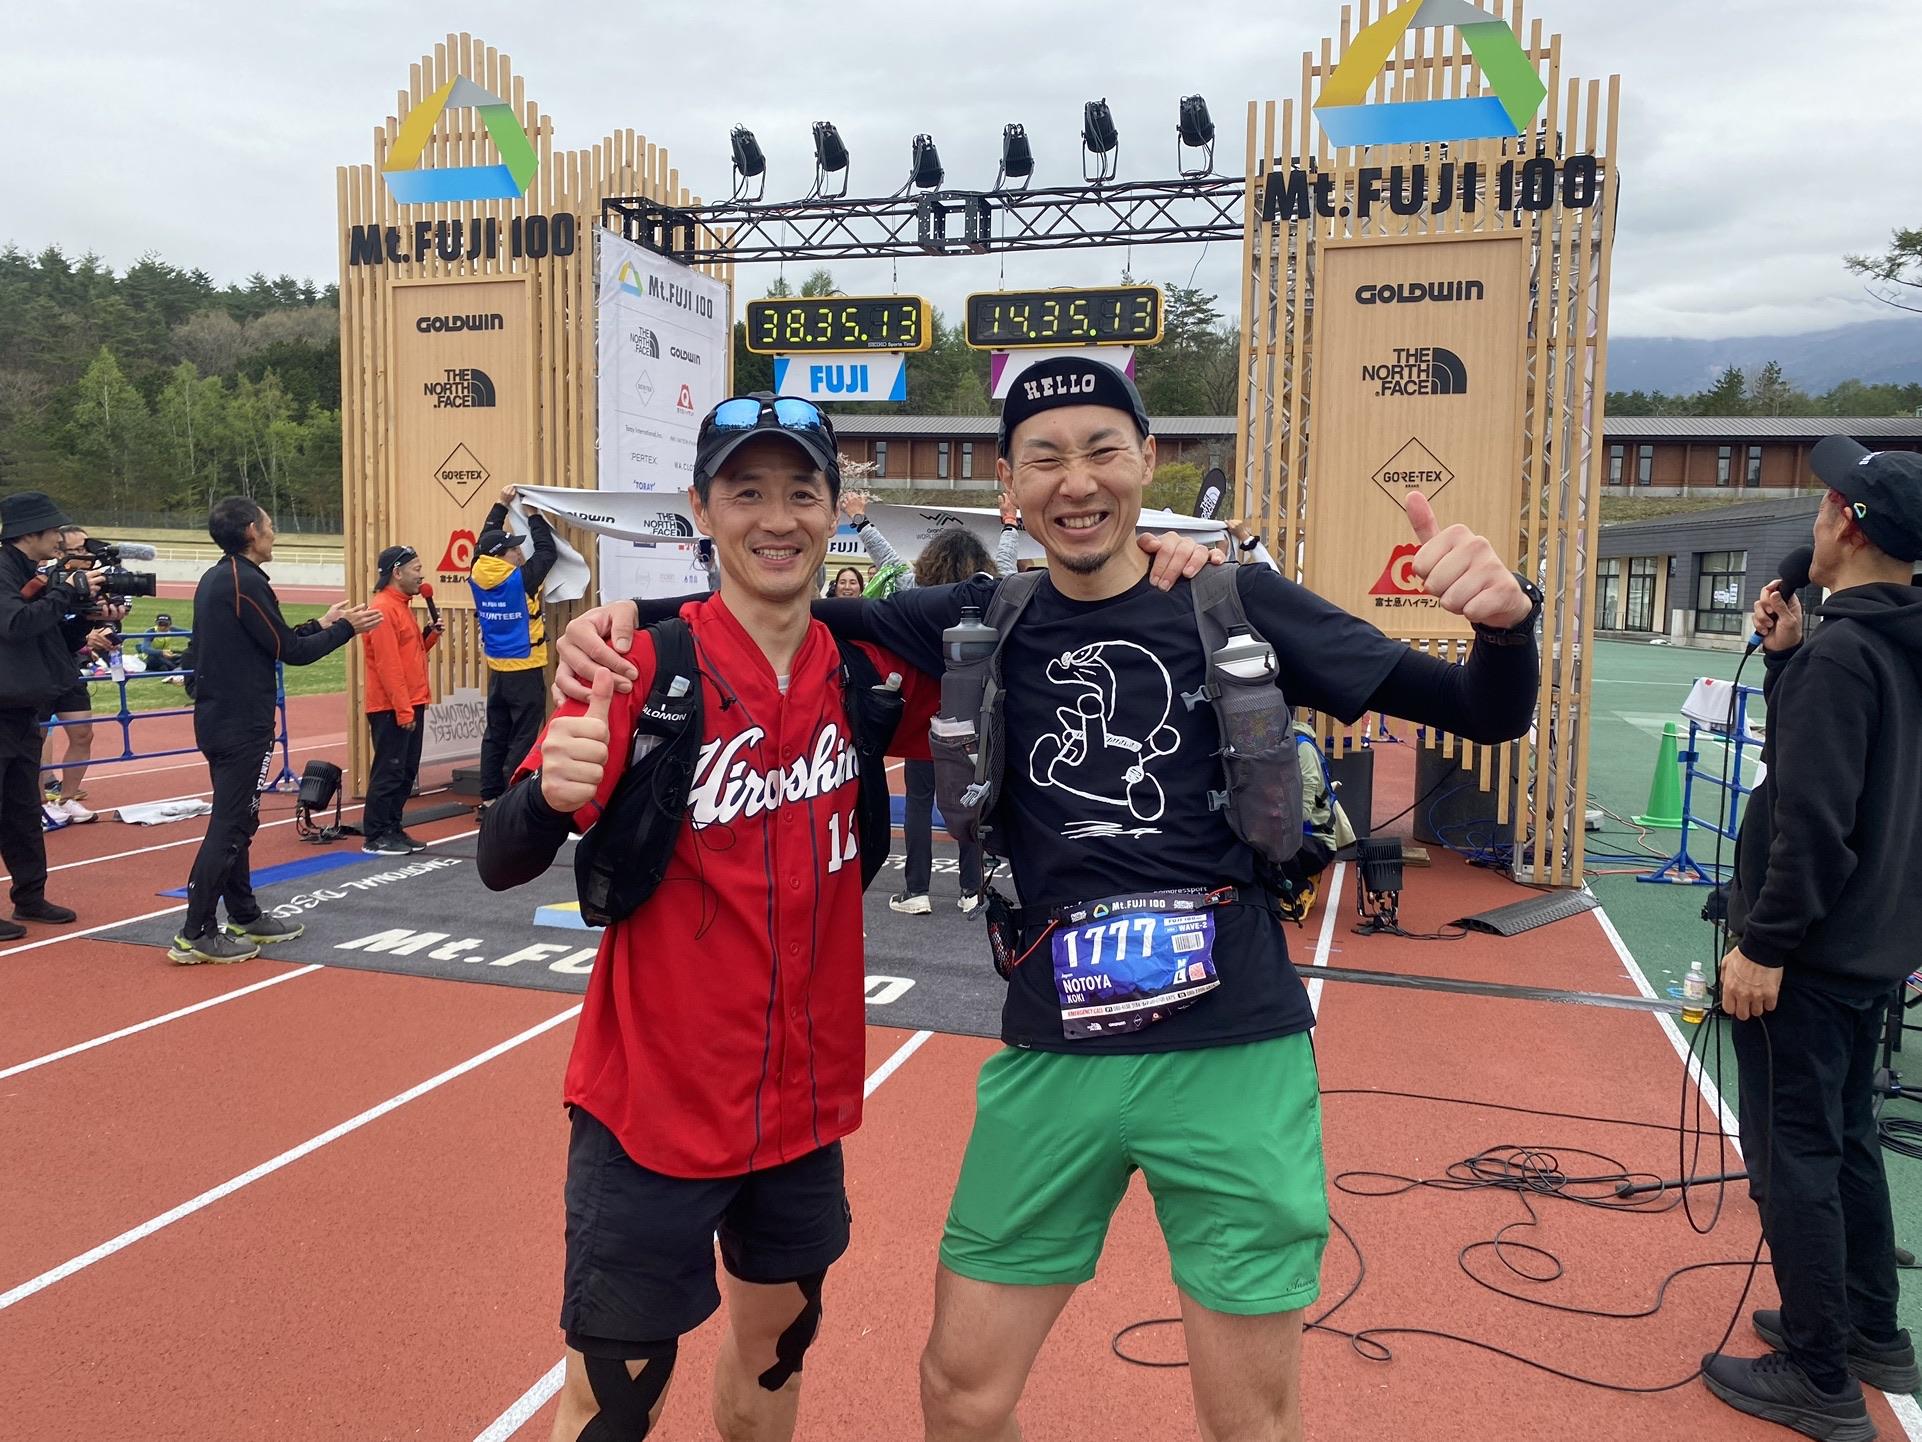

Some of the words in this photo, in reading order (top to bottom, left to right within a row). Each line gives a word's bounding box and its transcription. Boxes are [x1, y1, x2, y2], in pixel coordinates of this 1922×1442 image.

[1262, 161, 1477, 222] Mt.FUJI
[1498, 154, 1597, 212] 100
[350, 217, 496, 266] Mt.FUJI
[512, 212, 575, 259] 100
[648, 275, 692, 311] Mt.FUJI
[695, 294, 713, 319] 100
[630, 333, 650, 347] NORTH
[638, 327, 650, 338] THE
[1393, 347, 1431, 364] THE
[444, 368, 470, 382] THE
[809, 364, 869, 394] FUJI
[1362, 363, 1431, 381] NORTH
[424, 382, 470, 396] NORTH
[1023, 373, 1097, 401] HELLO
[1381, 380, 1430, 396] FACE
[441, 470, 482, 480] GORE-TEX
[1383, 470, 1442, 483] GORE-TEX
[656, 512, 675, 520] THE
[643, 520, 676, 529] NORTH
[652, 528, 676, 537] FACE
[642, 704, 688, 721] ALOMON
[1112, 899, 1147, 911] Mt.FUJI
[1149, 899, 1166, 908] 100
[1178, 921, 1208, 932] WAVE-2
[1063, 918, 1156, 968] 1777
[1062, 974, 1112, 993] NOTOYA
